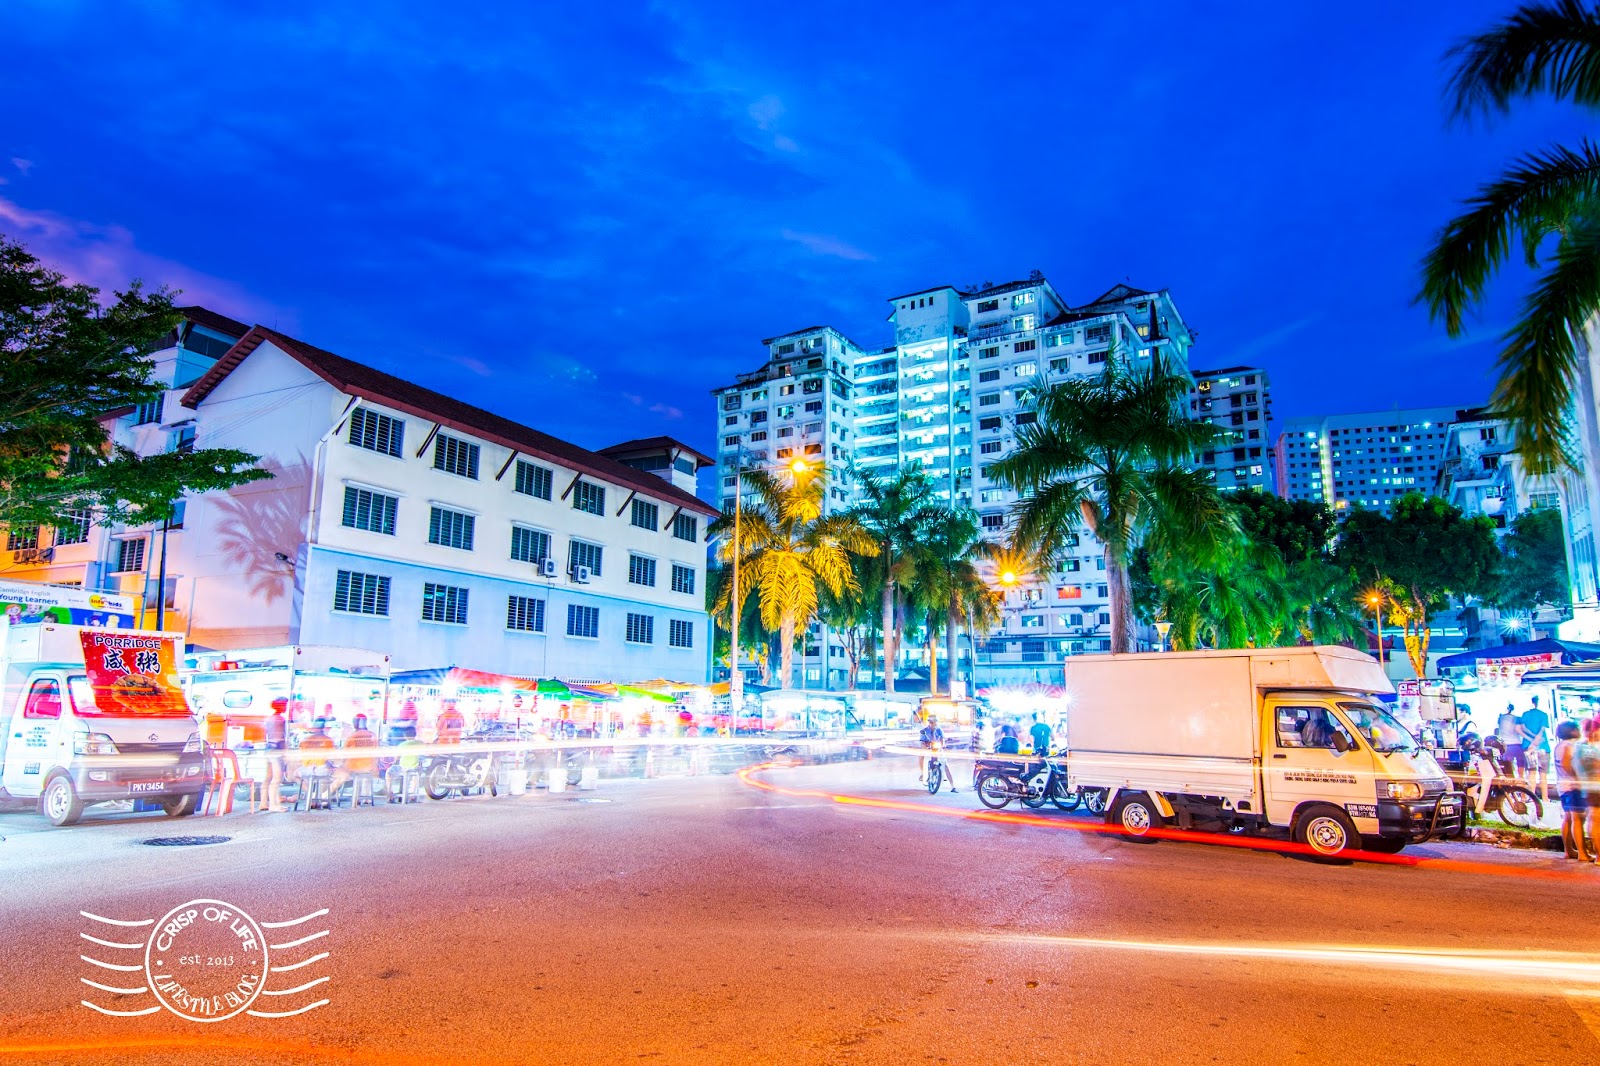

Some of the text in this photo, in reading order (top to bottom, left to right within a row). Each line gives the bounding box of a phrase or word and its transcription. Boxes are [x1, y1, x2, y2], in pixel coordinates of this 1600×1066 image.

[0, 594, 23, 603] Young
[25, 596, 59, 605] Learners
[95, 636, 161, 650] PORRIDGE
